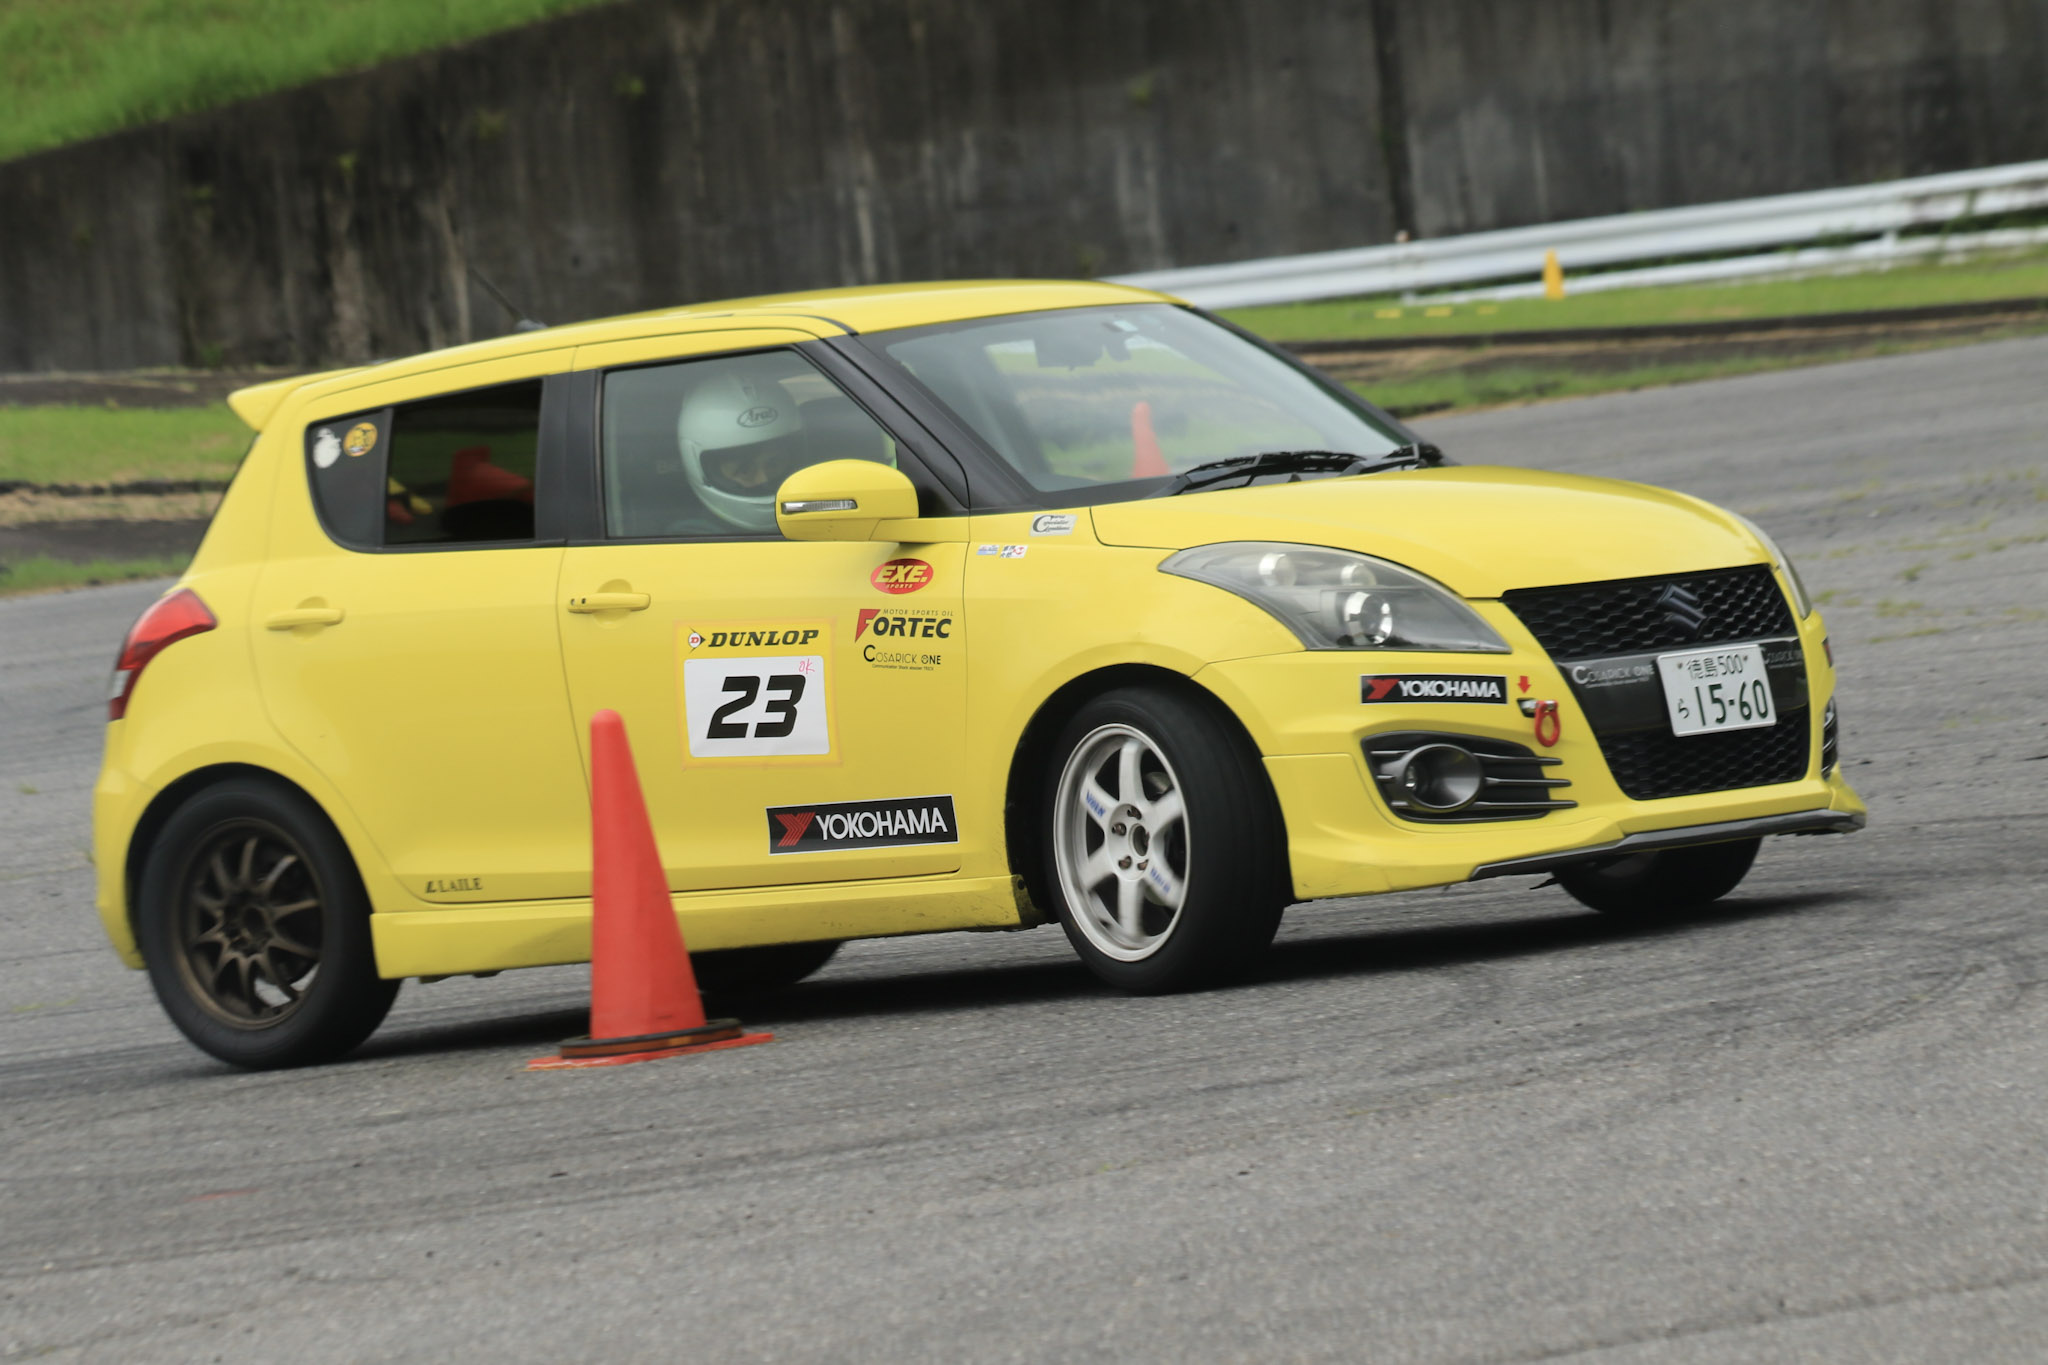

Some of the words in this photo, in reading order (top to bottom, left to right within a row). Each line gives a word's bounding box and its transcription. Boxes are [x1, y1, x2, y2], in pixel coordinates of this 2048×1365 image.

[707, 629, 819, 648] DUNLOP
[855, 608, 952, 643] FORTEC
[863, 644, 917, 664] COSARICK
[920, 654, 942, 665] ONE
[1398, 680, 1501, 698] YOKOHAMA
[1694, 679, 1769, 726] 15-60
[707, 674, 806, 739] 23
[1677, 698, 1690, 719] ら
[815, 807, 948, 840] YOKOHAMA
